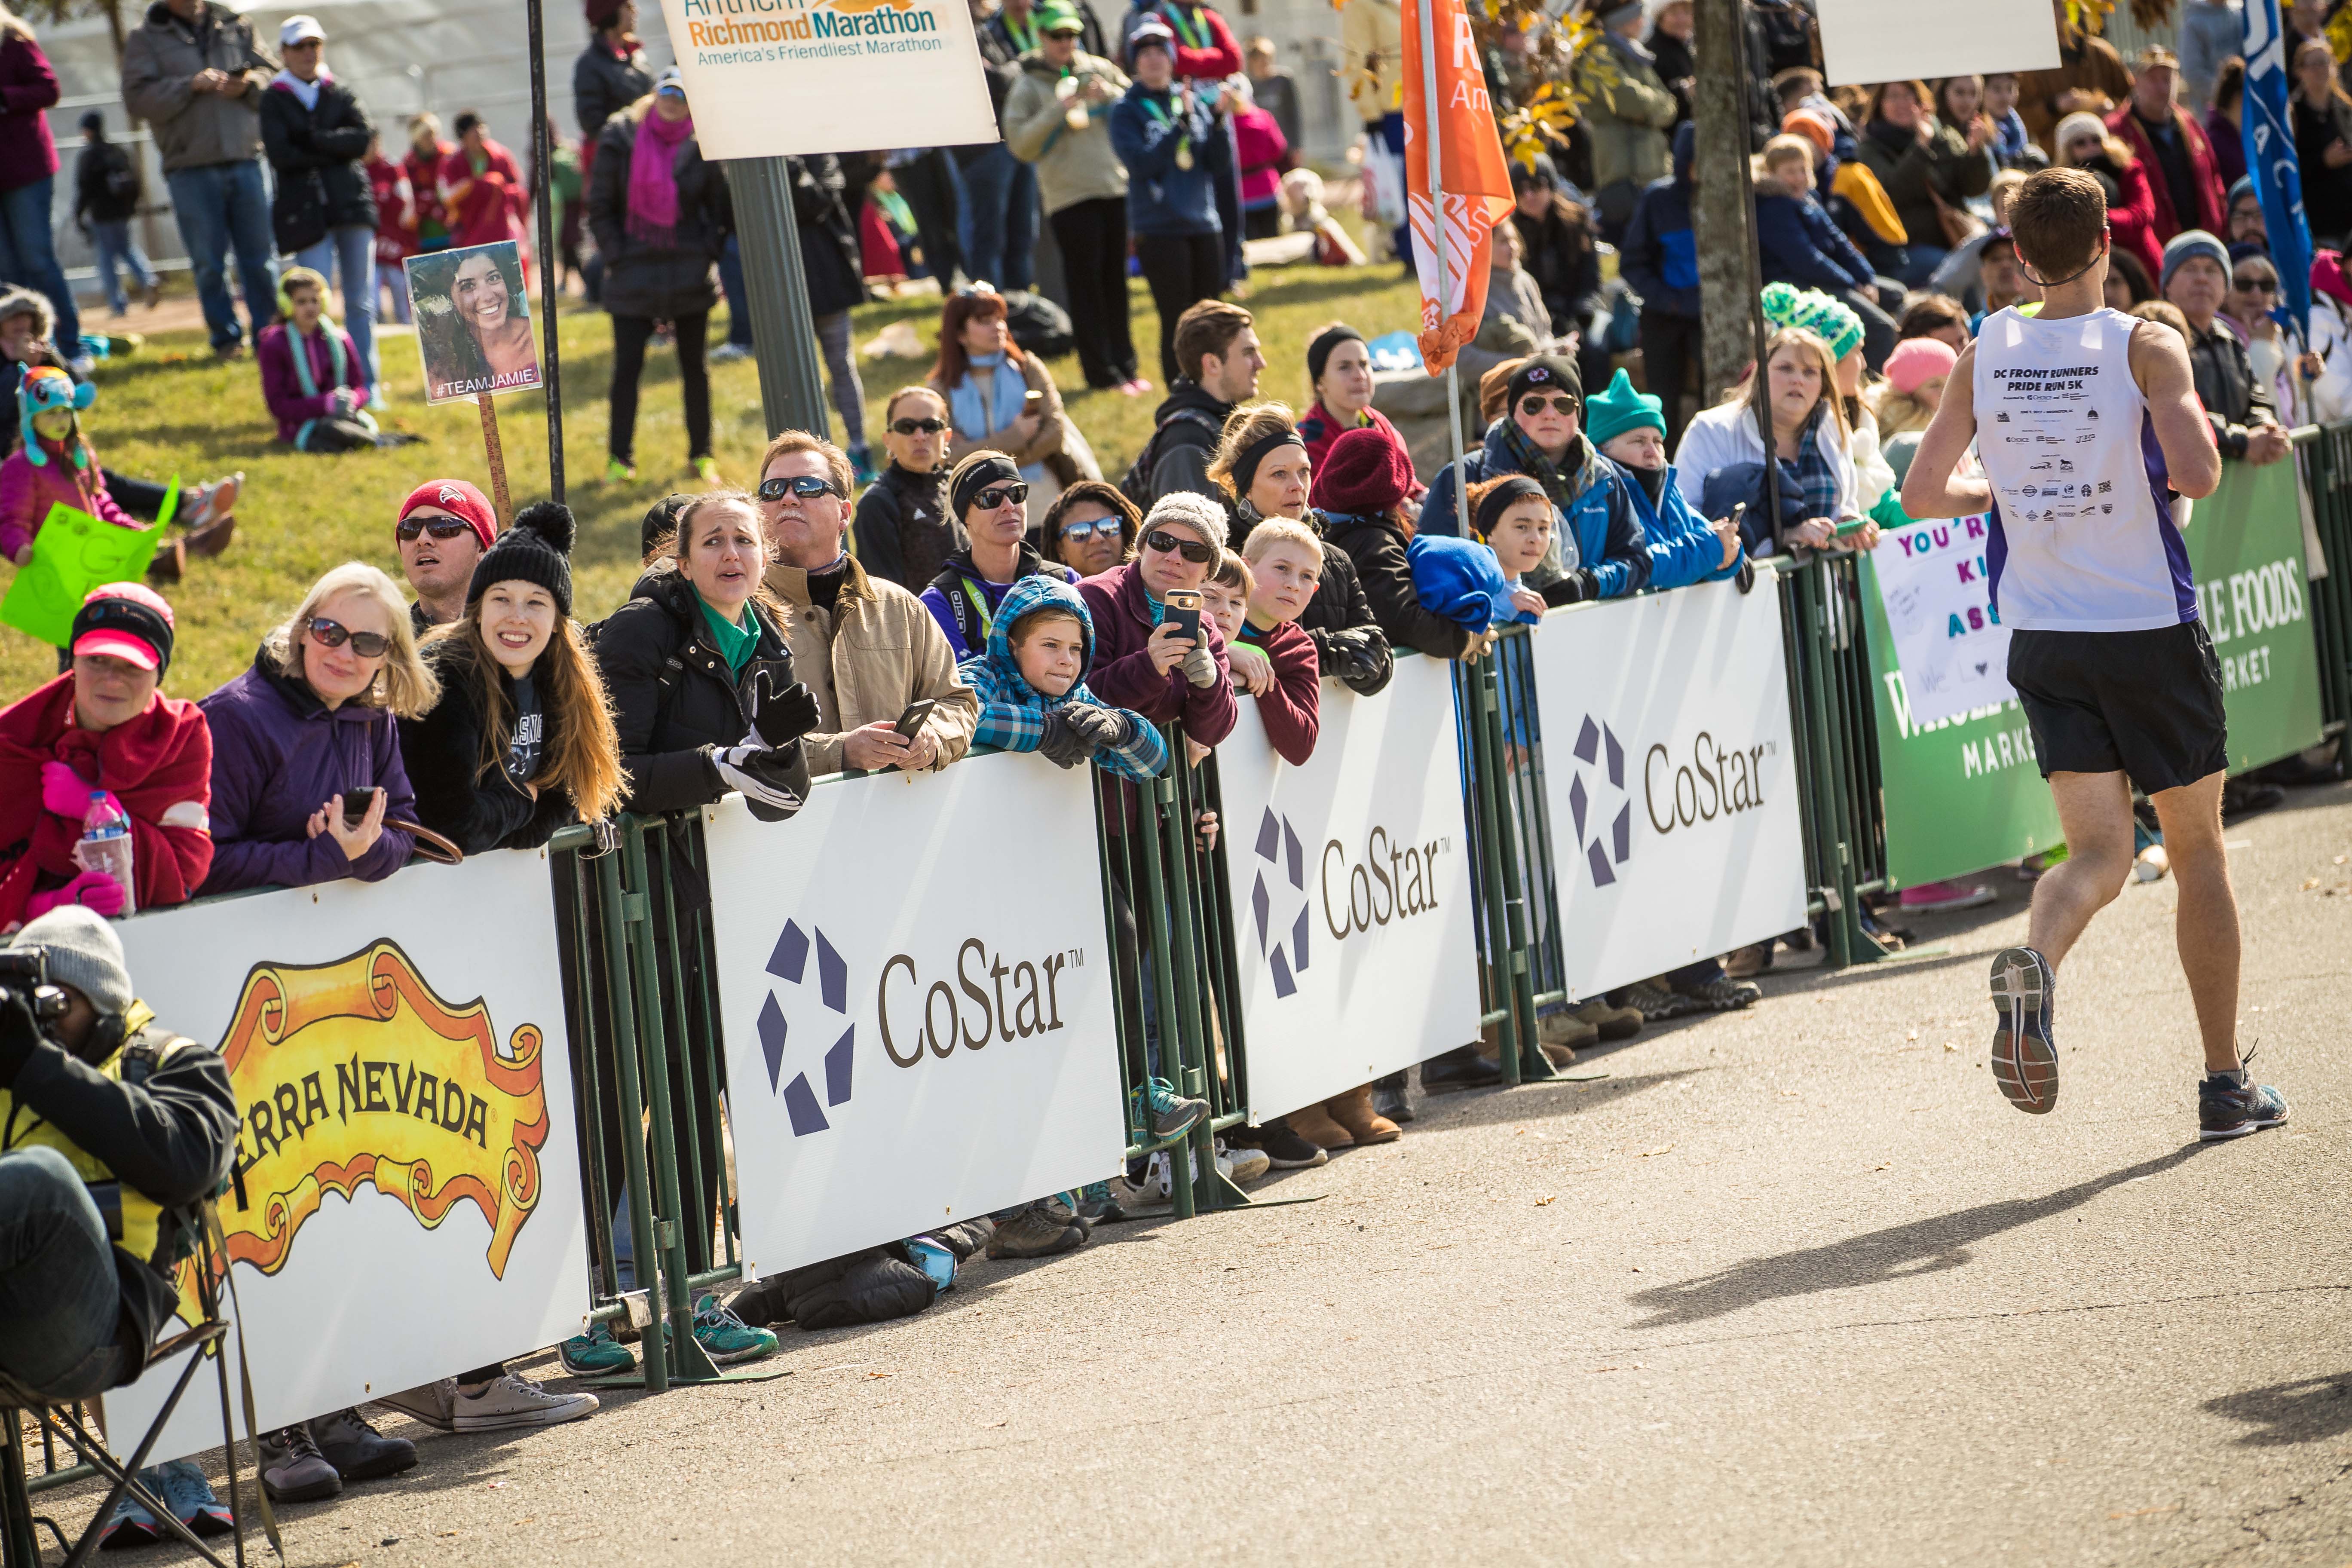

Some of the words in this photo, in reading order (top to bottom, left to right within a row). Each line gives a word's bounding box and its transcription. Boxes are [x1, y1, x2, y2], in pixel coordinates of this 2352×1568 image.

[688, 12, 812, 46] Richmond
[812, 6, 936, 38] Marathon
[698, 47, 775, 65] America's
[778, 41, 864, 60] Friendliest
[866, 37, 942, 54] Marathon
[436, 368, 534, 397] #TEAMJAMIE
[1994, 369, 2008, 379] DC
[2009, 369, 2050, 379] FRONT
[2050, 366, 2099, 379] RUNNERS
[2007, 382, 2043, 391] PRIDE
[2044, 381, 2065, 391] RUN
[2068, 380, 2084, 389] 5K
[485, 433, 495, 461] HOME
[491, 466, 502, 503] CENTER
[966, 464, 987, 482] saucony
[1956, 556, 1987, 584] KI
[950, 591, 966, 633] OGIO
[2223, 645, 2271, 693] RKET
[1962, 724, 2037, 779] MARKE
[1645, 731, 1764, 835] CoStar
[1322, 826, 1439, 940] CoStar
[878, 937, 1065, 1069] CoStar
[234, 1070, 330, 1179] ERRA
[335, 1052, 489, 1149] NEVADA
